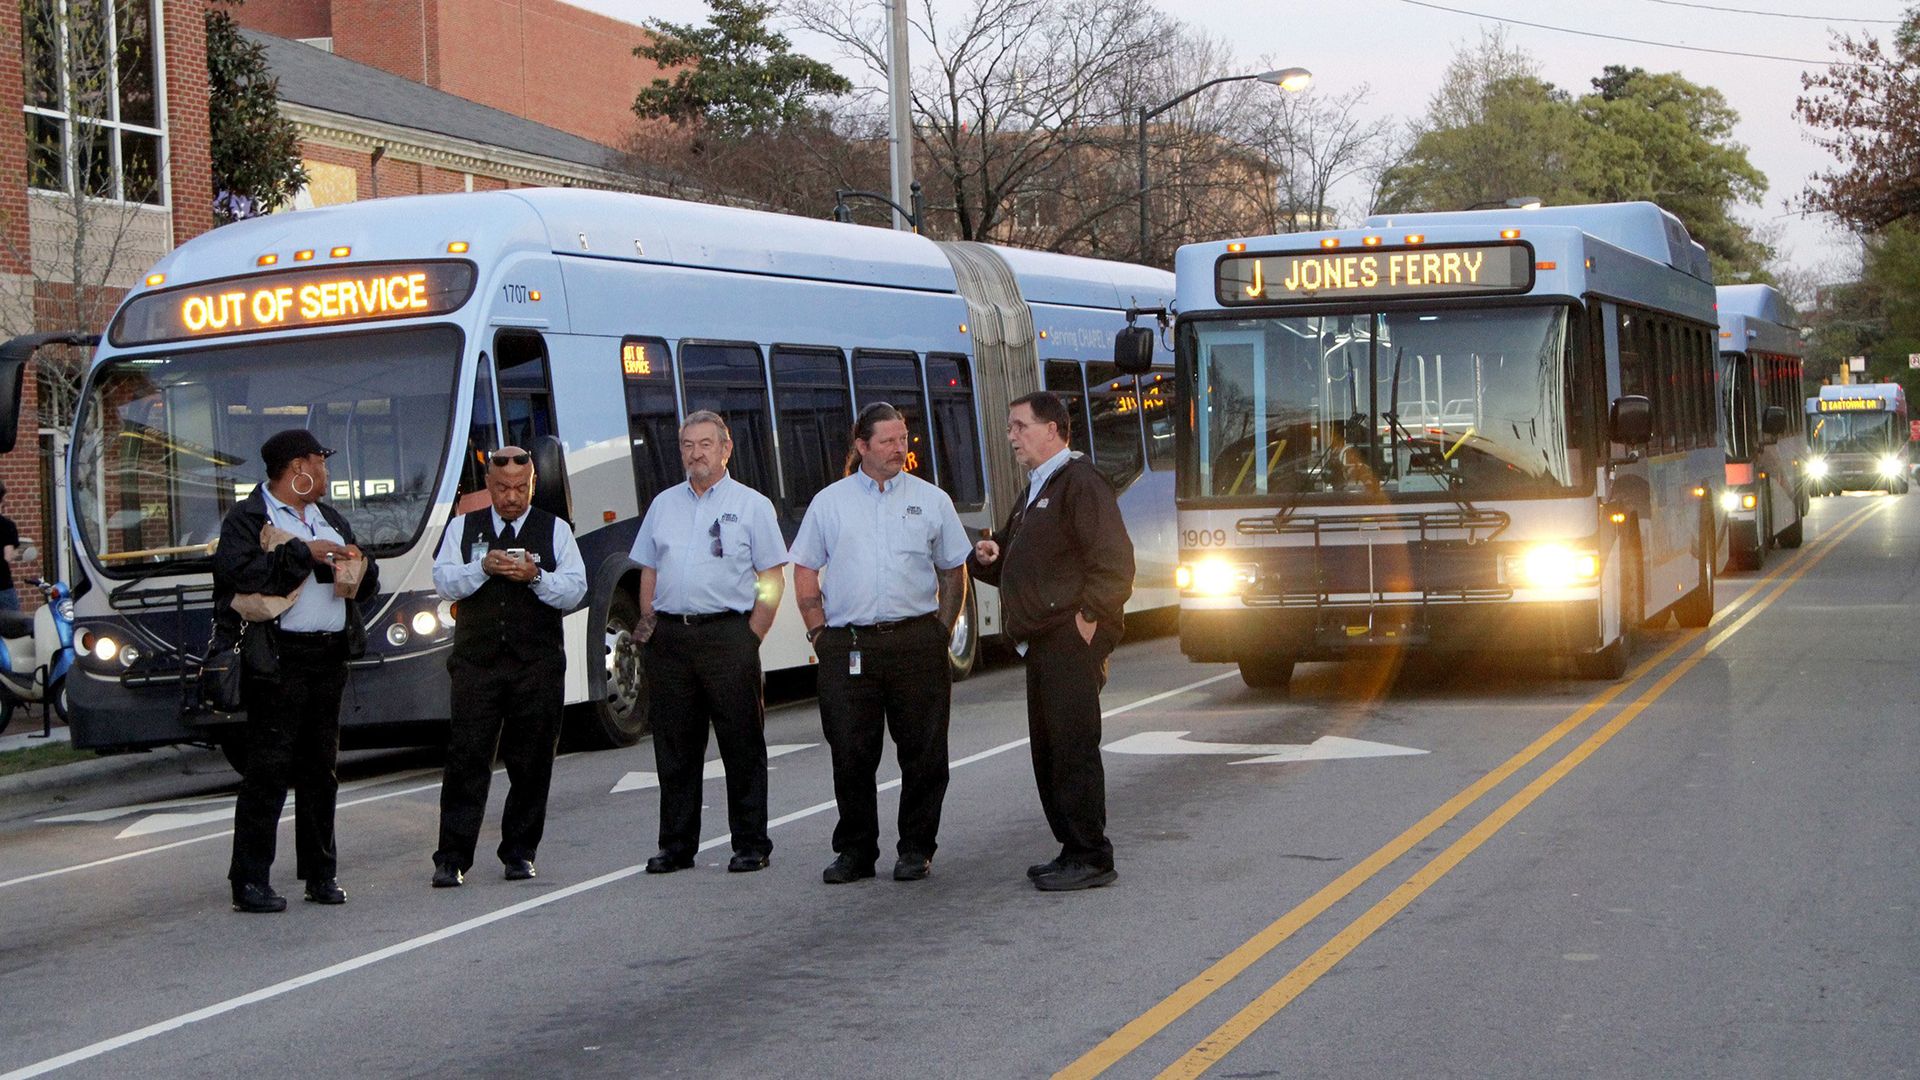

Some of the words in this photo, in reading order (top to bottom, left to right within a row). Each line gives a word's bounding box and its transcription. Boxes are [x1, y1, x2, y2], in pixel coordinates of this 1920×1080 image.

[1246, 259, 1262, 298] J
[1285, 256, 1378, 291] JONES
[1389, 251, 1483, 287] FERRY
[182, 292, 246, 331] OUT
[252, 287, 293, 324] OF
[299, 273, 428, 319] SERVICE
[502, 284, 527, 304] 1707
[1049, 326, 1078, 352] Serving
[1078, 327, 1106, 349] CHAPEL
[624, 360, 651, 374] ERVICE
[1182, 529, 1226, 547] 1909
